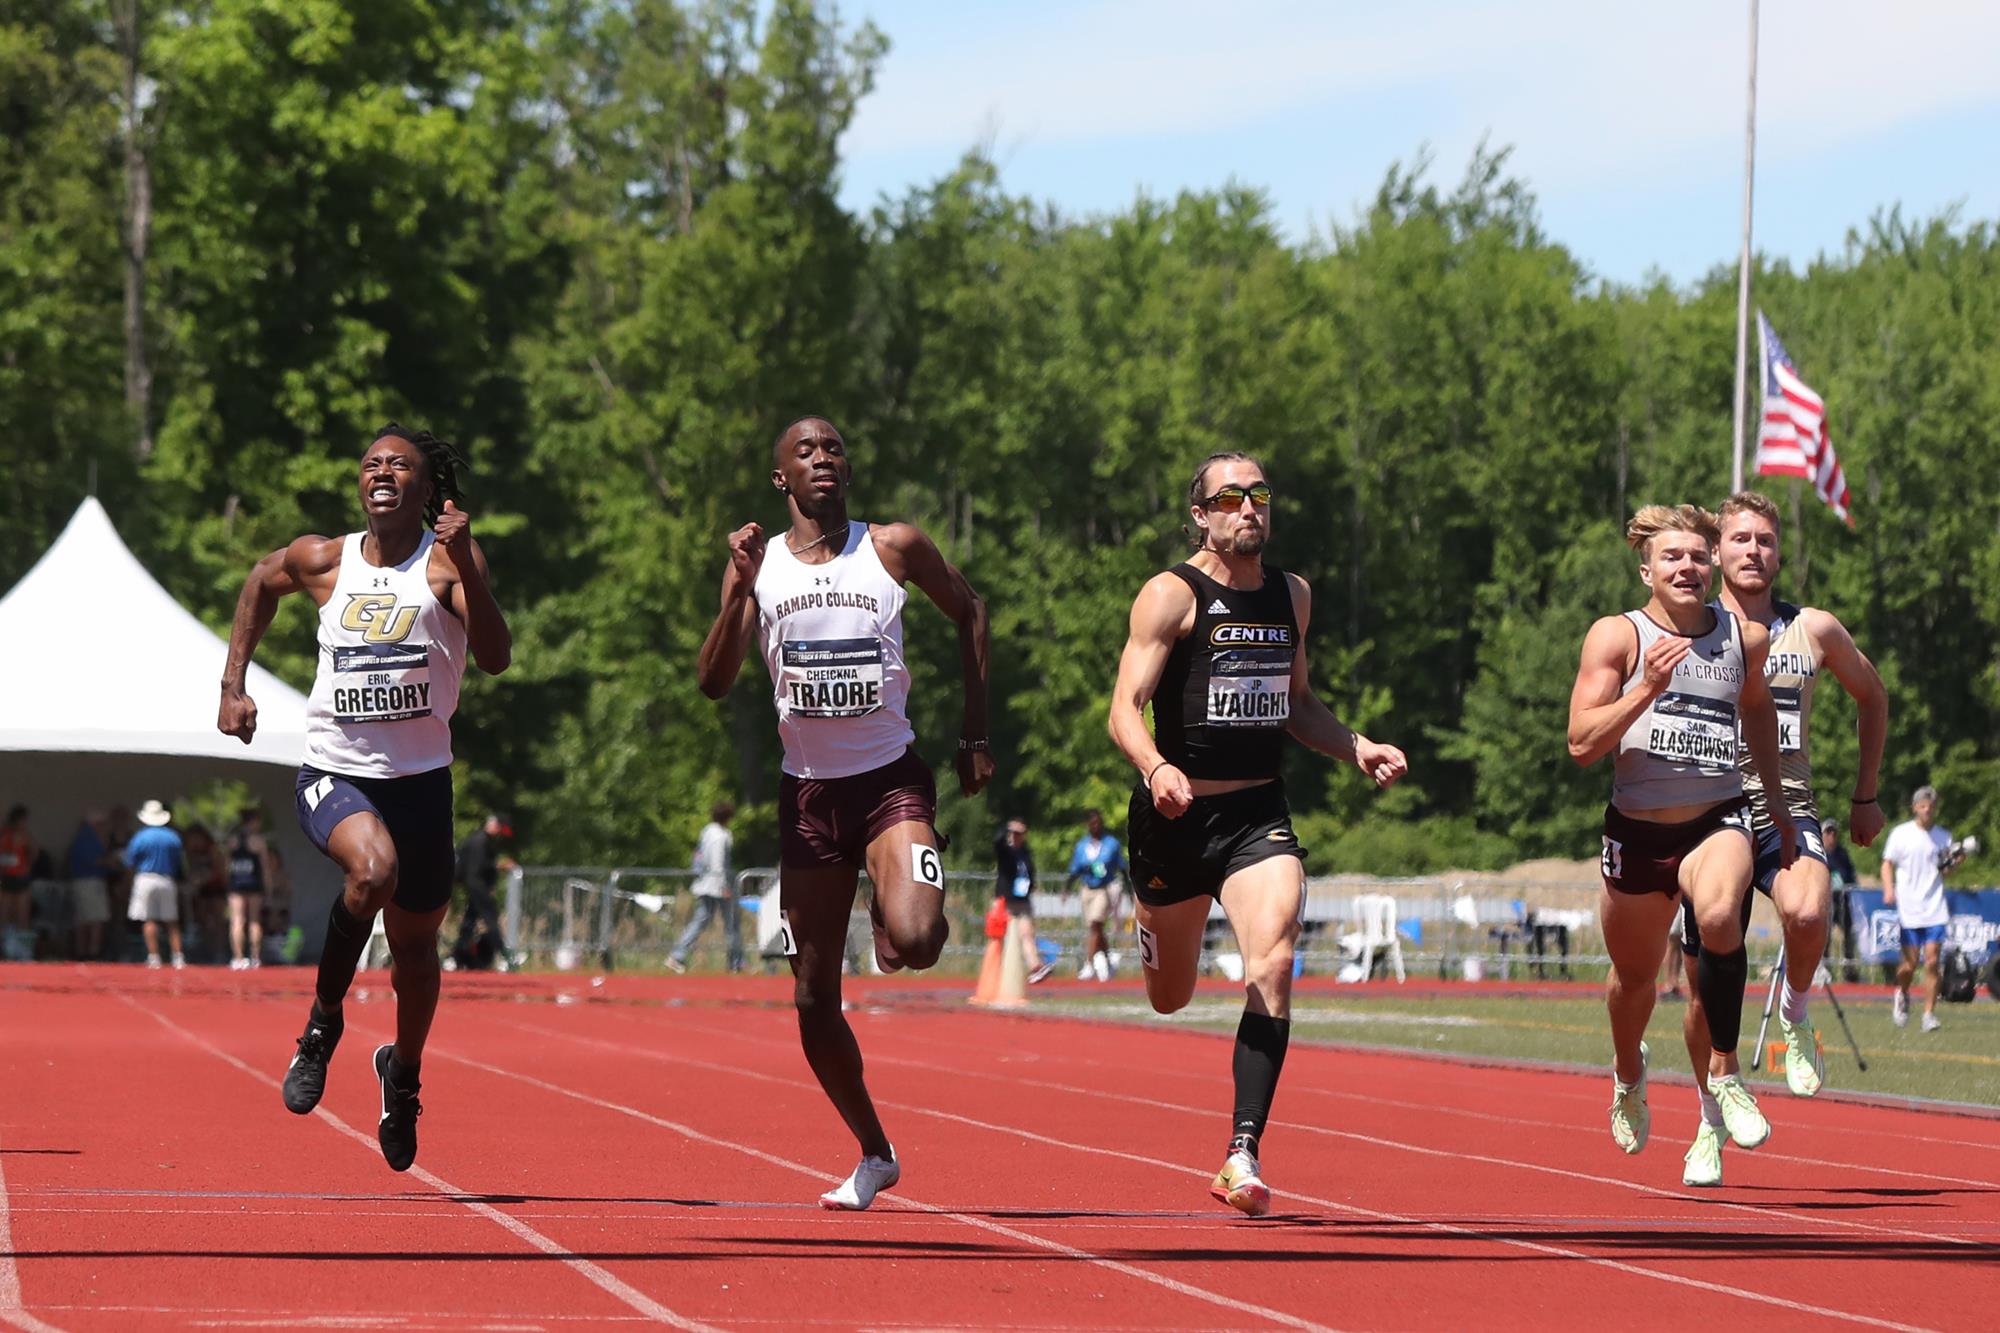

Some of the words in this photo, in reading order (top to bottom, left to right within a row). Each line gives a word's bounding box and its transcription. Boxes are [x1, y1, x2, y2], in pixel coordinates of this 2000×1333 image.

[341, 593, 421, 644] GU
[776, 593, 823, 620] RAMAPO
[826, 592, 879, 614] COLLEGE
[1214, 627, 1289, 642] CENTRE
[806, 669, 858, 681] CHEICKNA
[1675, 663, 1691, 678] LA
[1695, 666, 1742, 684] CROSSE
[1764, 653, 1814, 677] RROLL
[368, 674, 391, 685] ERIC
[1251, 680, 1262, 690] JP
[334, 683, 430, 712] GREGORY
[789, 681, 879, 707] TRAORE
[1213, 691, 1287, 718] VAUGHT
[1687, 721, 1707, 733] SAM
[1650, 728, 1735, 762] BLASKOWSKI
[920, 849, 939, 883] 6
[1139, 927, 1153, 964] 5
